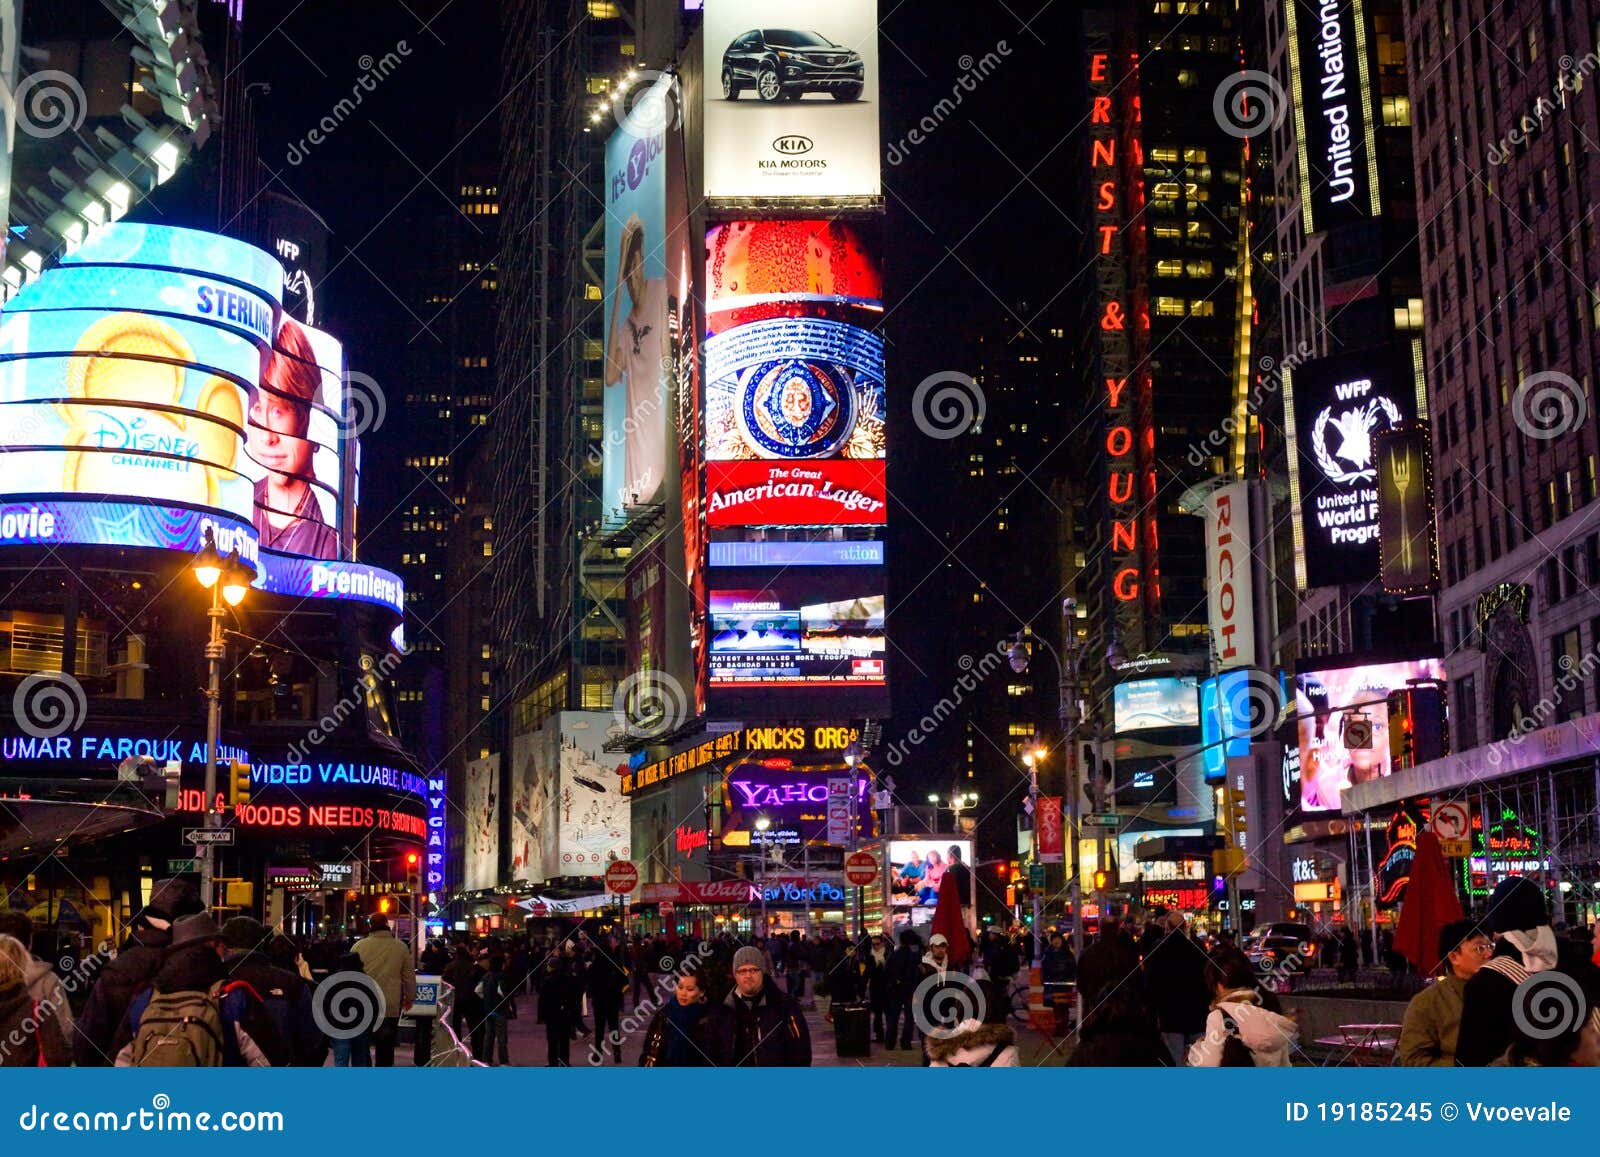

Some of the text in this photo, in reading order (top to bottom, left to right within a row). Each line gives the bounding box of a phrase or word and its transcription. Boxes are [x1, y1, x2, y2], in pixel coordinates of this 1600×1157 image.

[780, 139, 806, 150] KIA
[1323, 105, 1355, 203] United
[758, 160, 827, 169] KIA MOTORS
[197, 285, 272, 340] STERLING
[1091, 54, 1140, 600] ERNST & YOUNG
[1335, 379, 1372, 401] WFP
[769, 467, 822, 479] The Great
[708, 480, 884, 513] American Lager
[1317, 490, 1358, 510] United
[0, 507, 54, 539] ovie
[1317, 506, 1366, 528] World
[311, 564, 396, 604] Premieres
[1216, 495, 1237, 660] RICOH
[733, 602, 780, 611] AFGHANISTAN
[1309, 686, 1327, 697] Help
[3, 737, 71, 759] UMAR
[82, 737, 182, 761] FAROUK
[746, 727, 805, 750] KNICKS
[764, 759, 792, 768] VACANCY
[318, 763, 401, 791] VALUABLE,
[174, 789, 226, 814] SIDIG
[732, 779, 867, 807] YAHO!
[309, 806, 374, 828] NEEDS
[377, 809, 391, 829] TO
[190, 832, 228, 842] ONE WAY
[1490, 837, 1531, 849] Had Rok
[320, 864, 352, 874] BUCKS
[749, 884, 780, 901] NEW
[781, 882, 817, 901] YORK
[1218, 900, 1256, 911] CSE
[418, 986, 434, 994] USA
